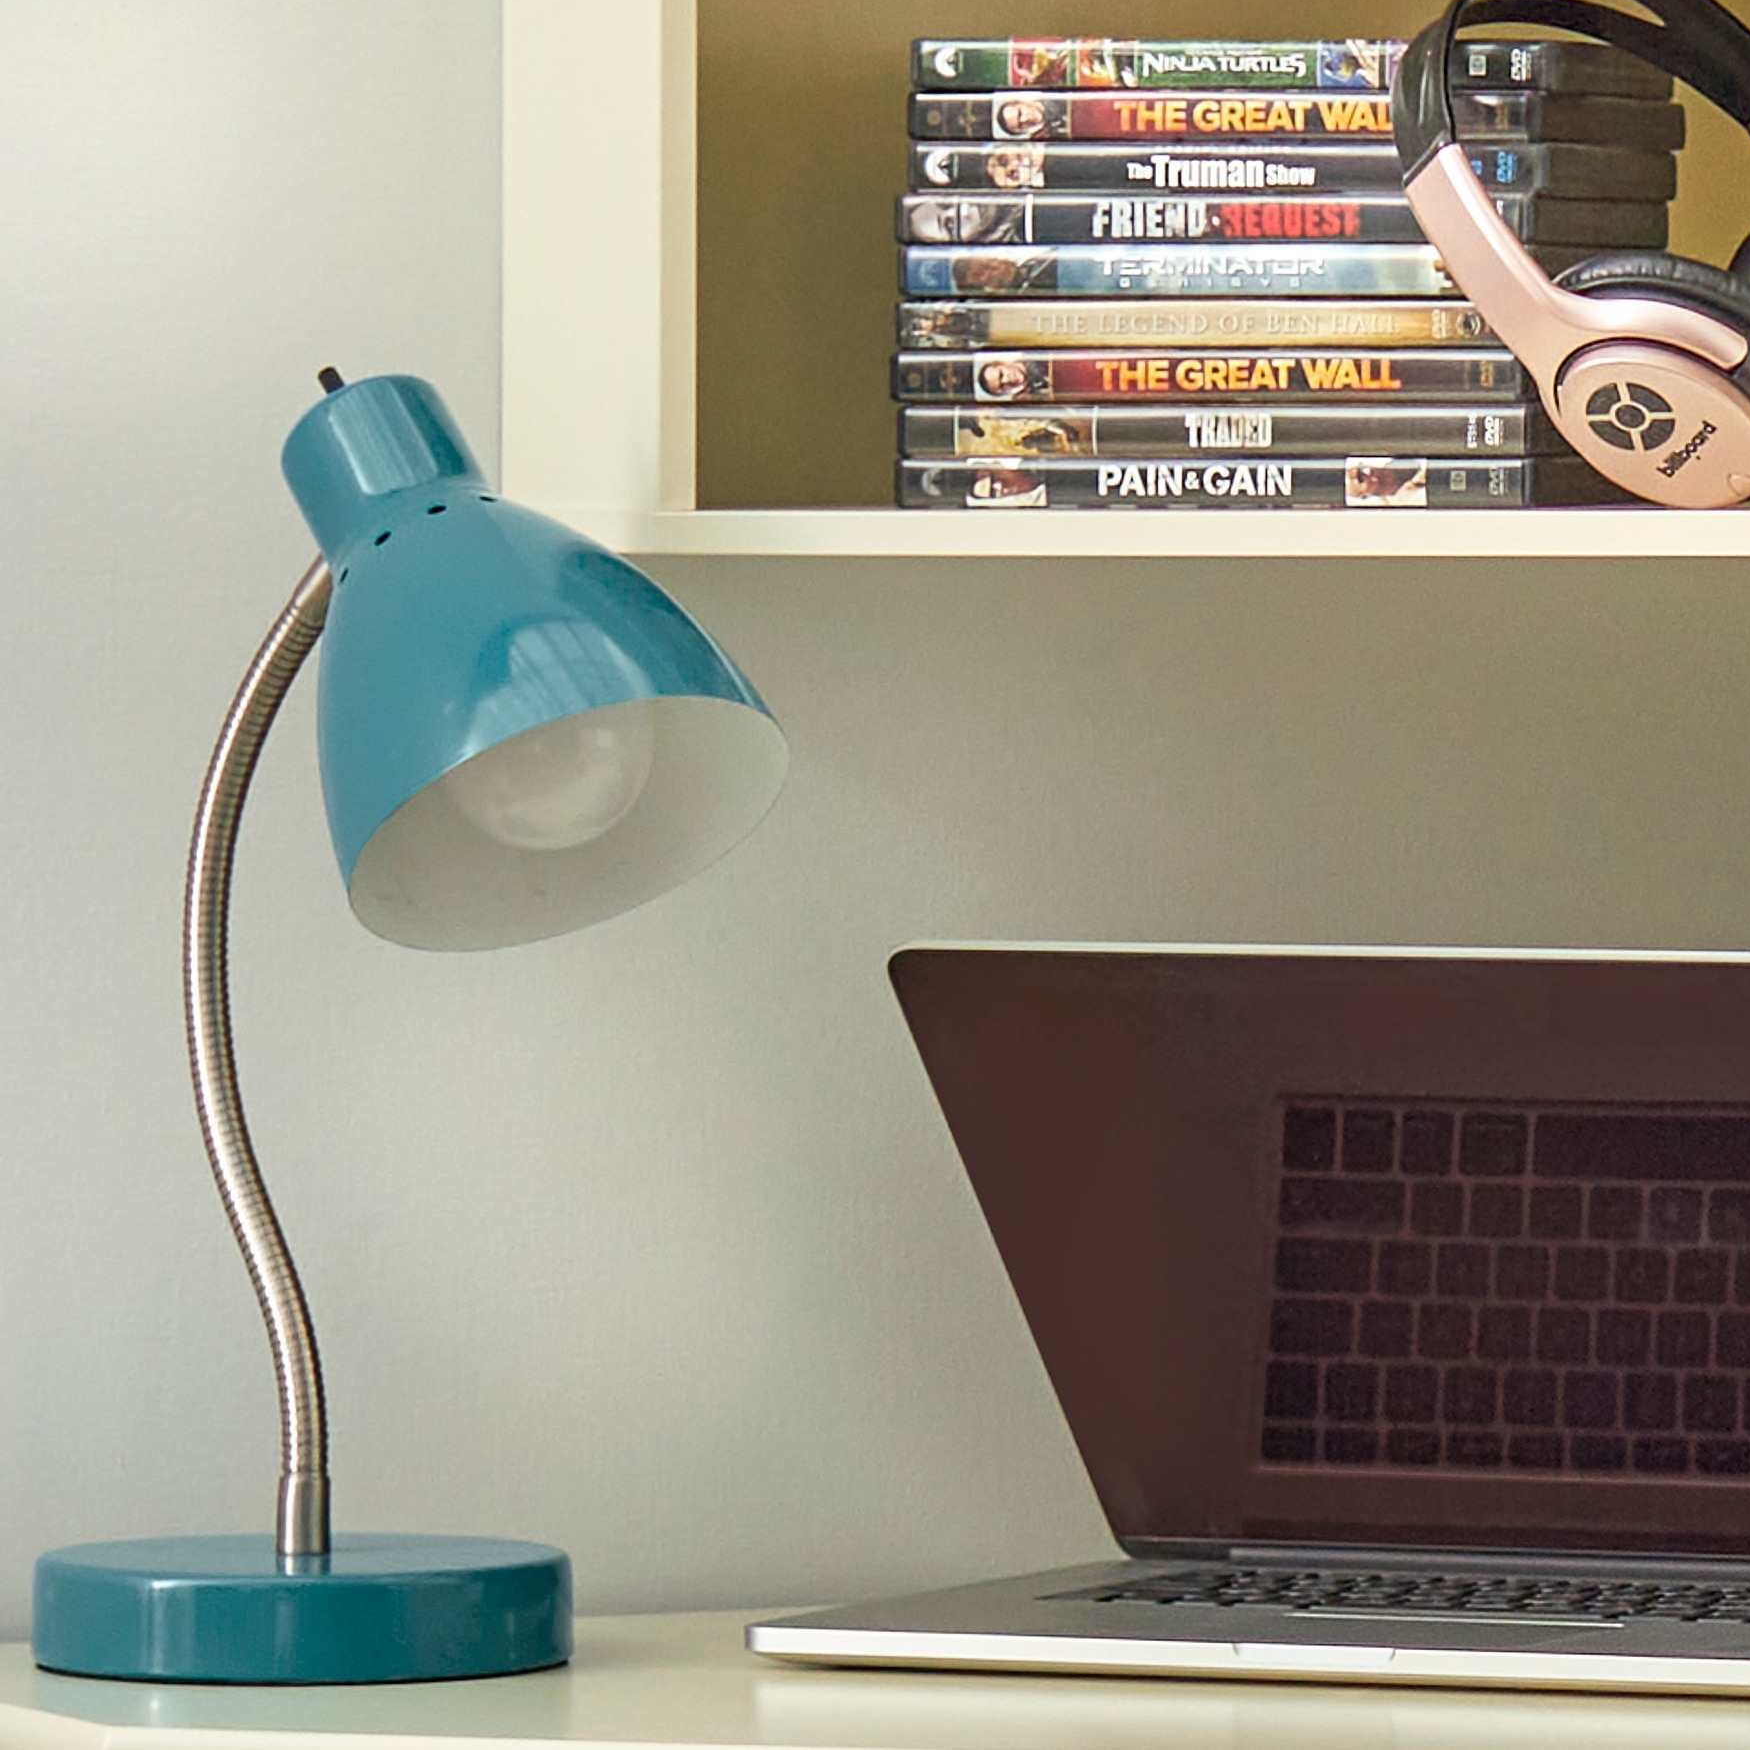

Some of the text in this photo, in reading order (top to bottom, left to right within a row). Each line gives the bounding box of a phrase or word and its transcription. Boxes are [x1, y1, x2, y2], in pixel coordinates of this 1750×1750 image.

[1141, 52, 1307, 78] NINJA TURTLES
[1113, 100, 1394, 133] THE GREAT WAL
[1126, 161, 1153, 180] The
[1151, 155, 1265, 188] Truman
[1092, 201, 1361, 238] FRIEND REQUEST
[1094, 253, 1325, 276] TERMINATOR
[1032, 313, 1401, 335] THE LEGEND OF BEN HALL
[1094, 358, 1402, 391] THE GREAT WALL
[1184, 413, 1273, 448] TRADED
